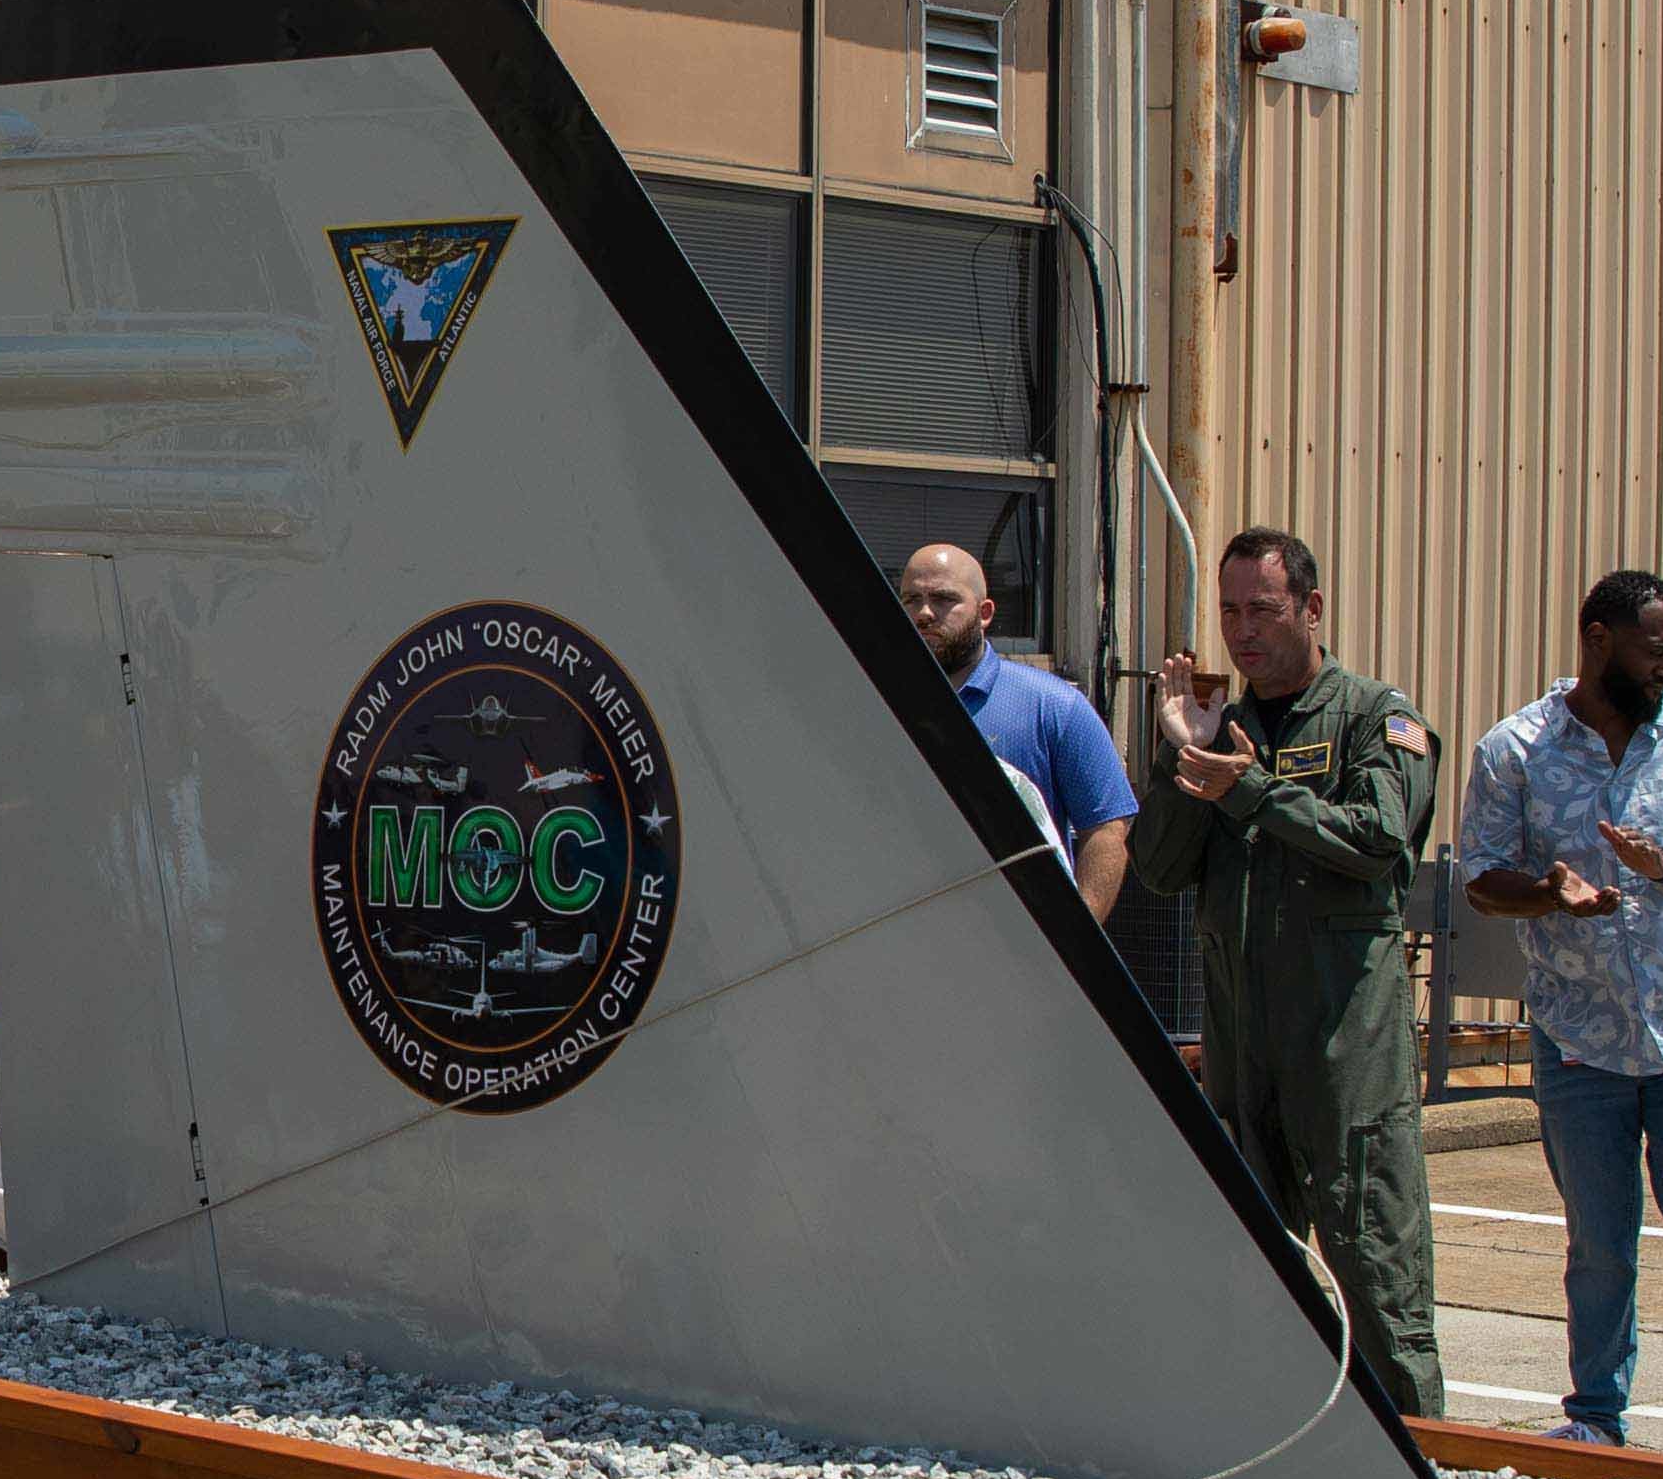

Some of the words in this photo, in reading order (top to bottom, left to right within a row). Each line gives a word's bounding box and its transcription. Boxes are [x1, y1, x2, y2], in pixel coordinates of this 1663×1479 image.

[346, 269, 369, 317] NAVAL
[363, 317, 379, 342] AIR
[372, 340, 396, 392] FORCE
[437, 290, 478, 362] ATLANTIC
[335, 680, 392, 776] RADM
[395, 624, 464, 687] JOHN
[588, 673, 655, 784] MEIER
[368, 804, 606, 915] MOC
[322, 863, 439, 1080] MAINTENANCE
[444, 1019, 601, 1095] OPERATION
[599, 872, 665, 1021] CENTER
